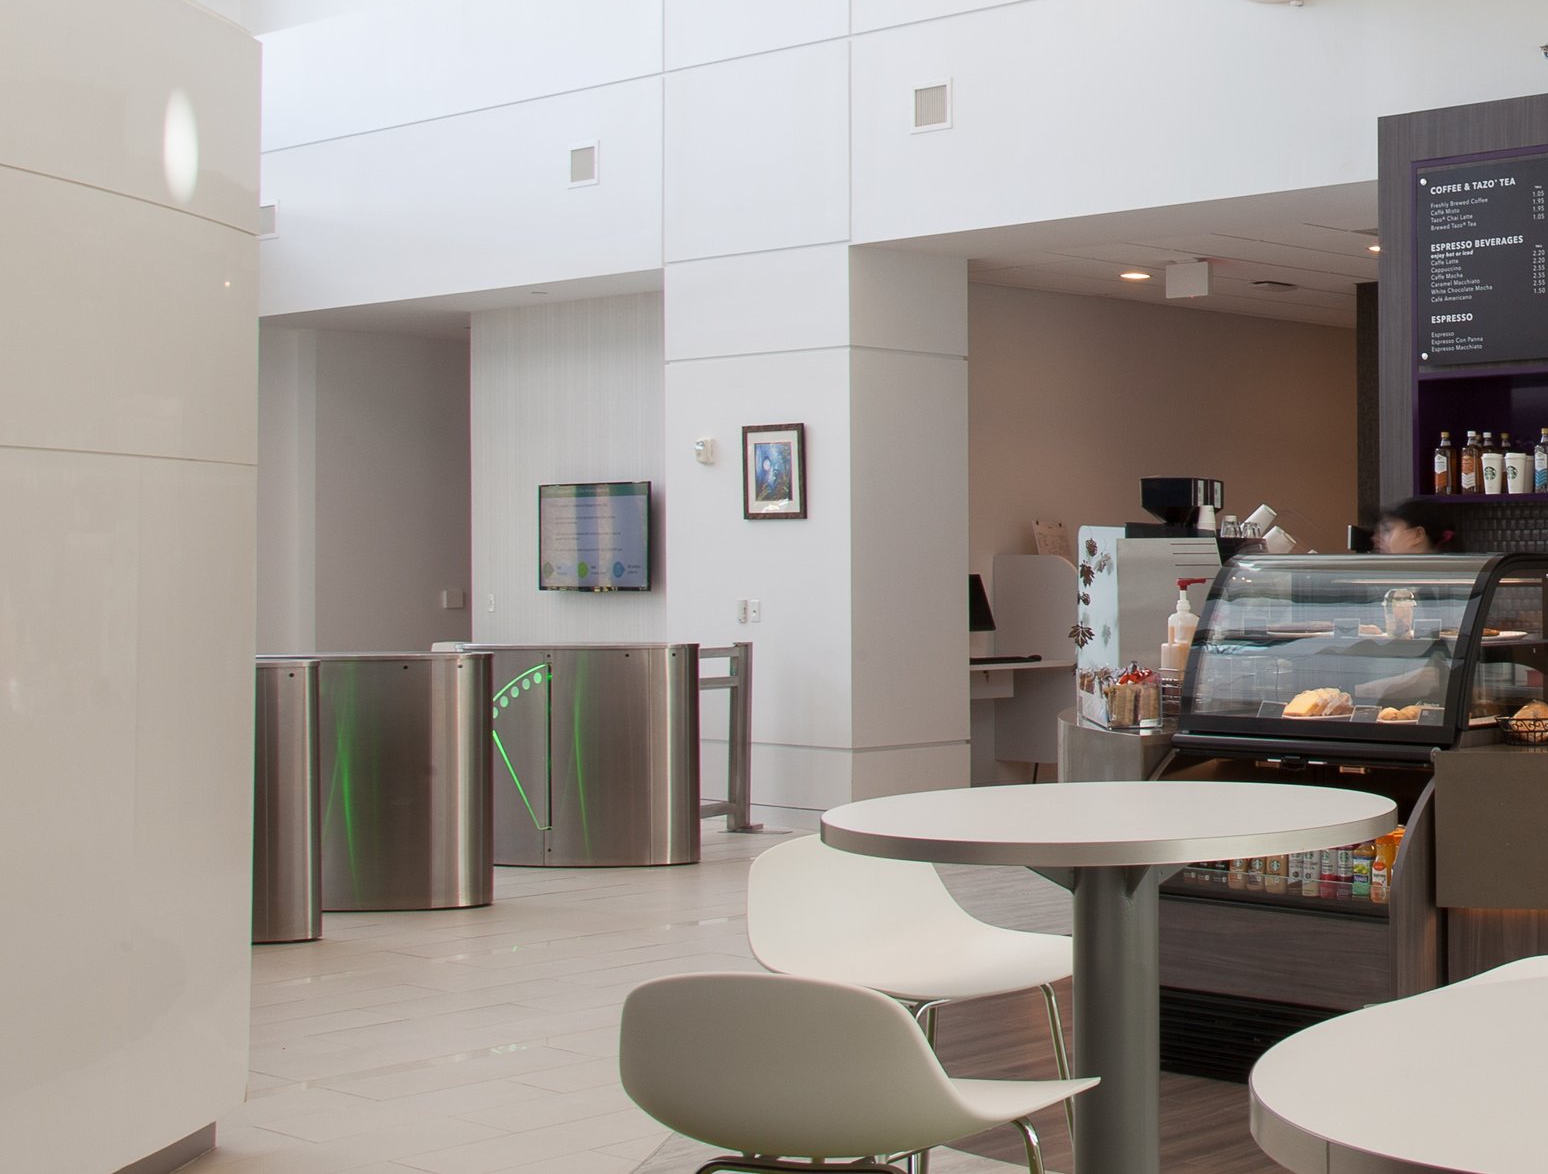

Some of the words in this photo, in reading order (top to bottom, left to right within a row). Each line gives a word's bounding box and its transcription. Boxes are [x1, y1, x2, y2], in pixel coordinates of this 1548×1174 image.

[1430, 184, 1462, 194] COFFEE
[1464, 183, 1470, 191] &
[1499, 178, 1516, 186] TEA
[1450, 199, 1470, 207] Brewed
[1430, 241, 1473, 252] ESPRESSO
[1474, 235, 1524, 247] BEVERAGES
[1447, 286, 1474, 294] Chocolate
[1431, 313, 1473, 324] ESPRESSO
